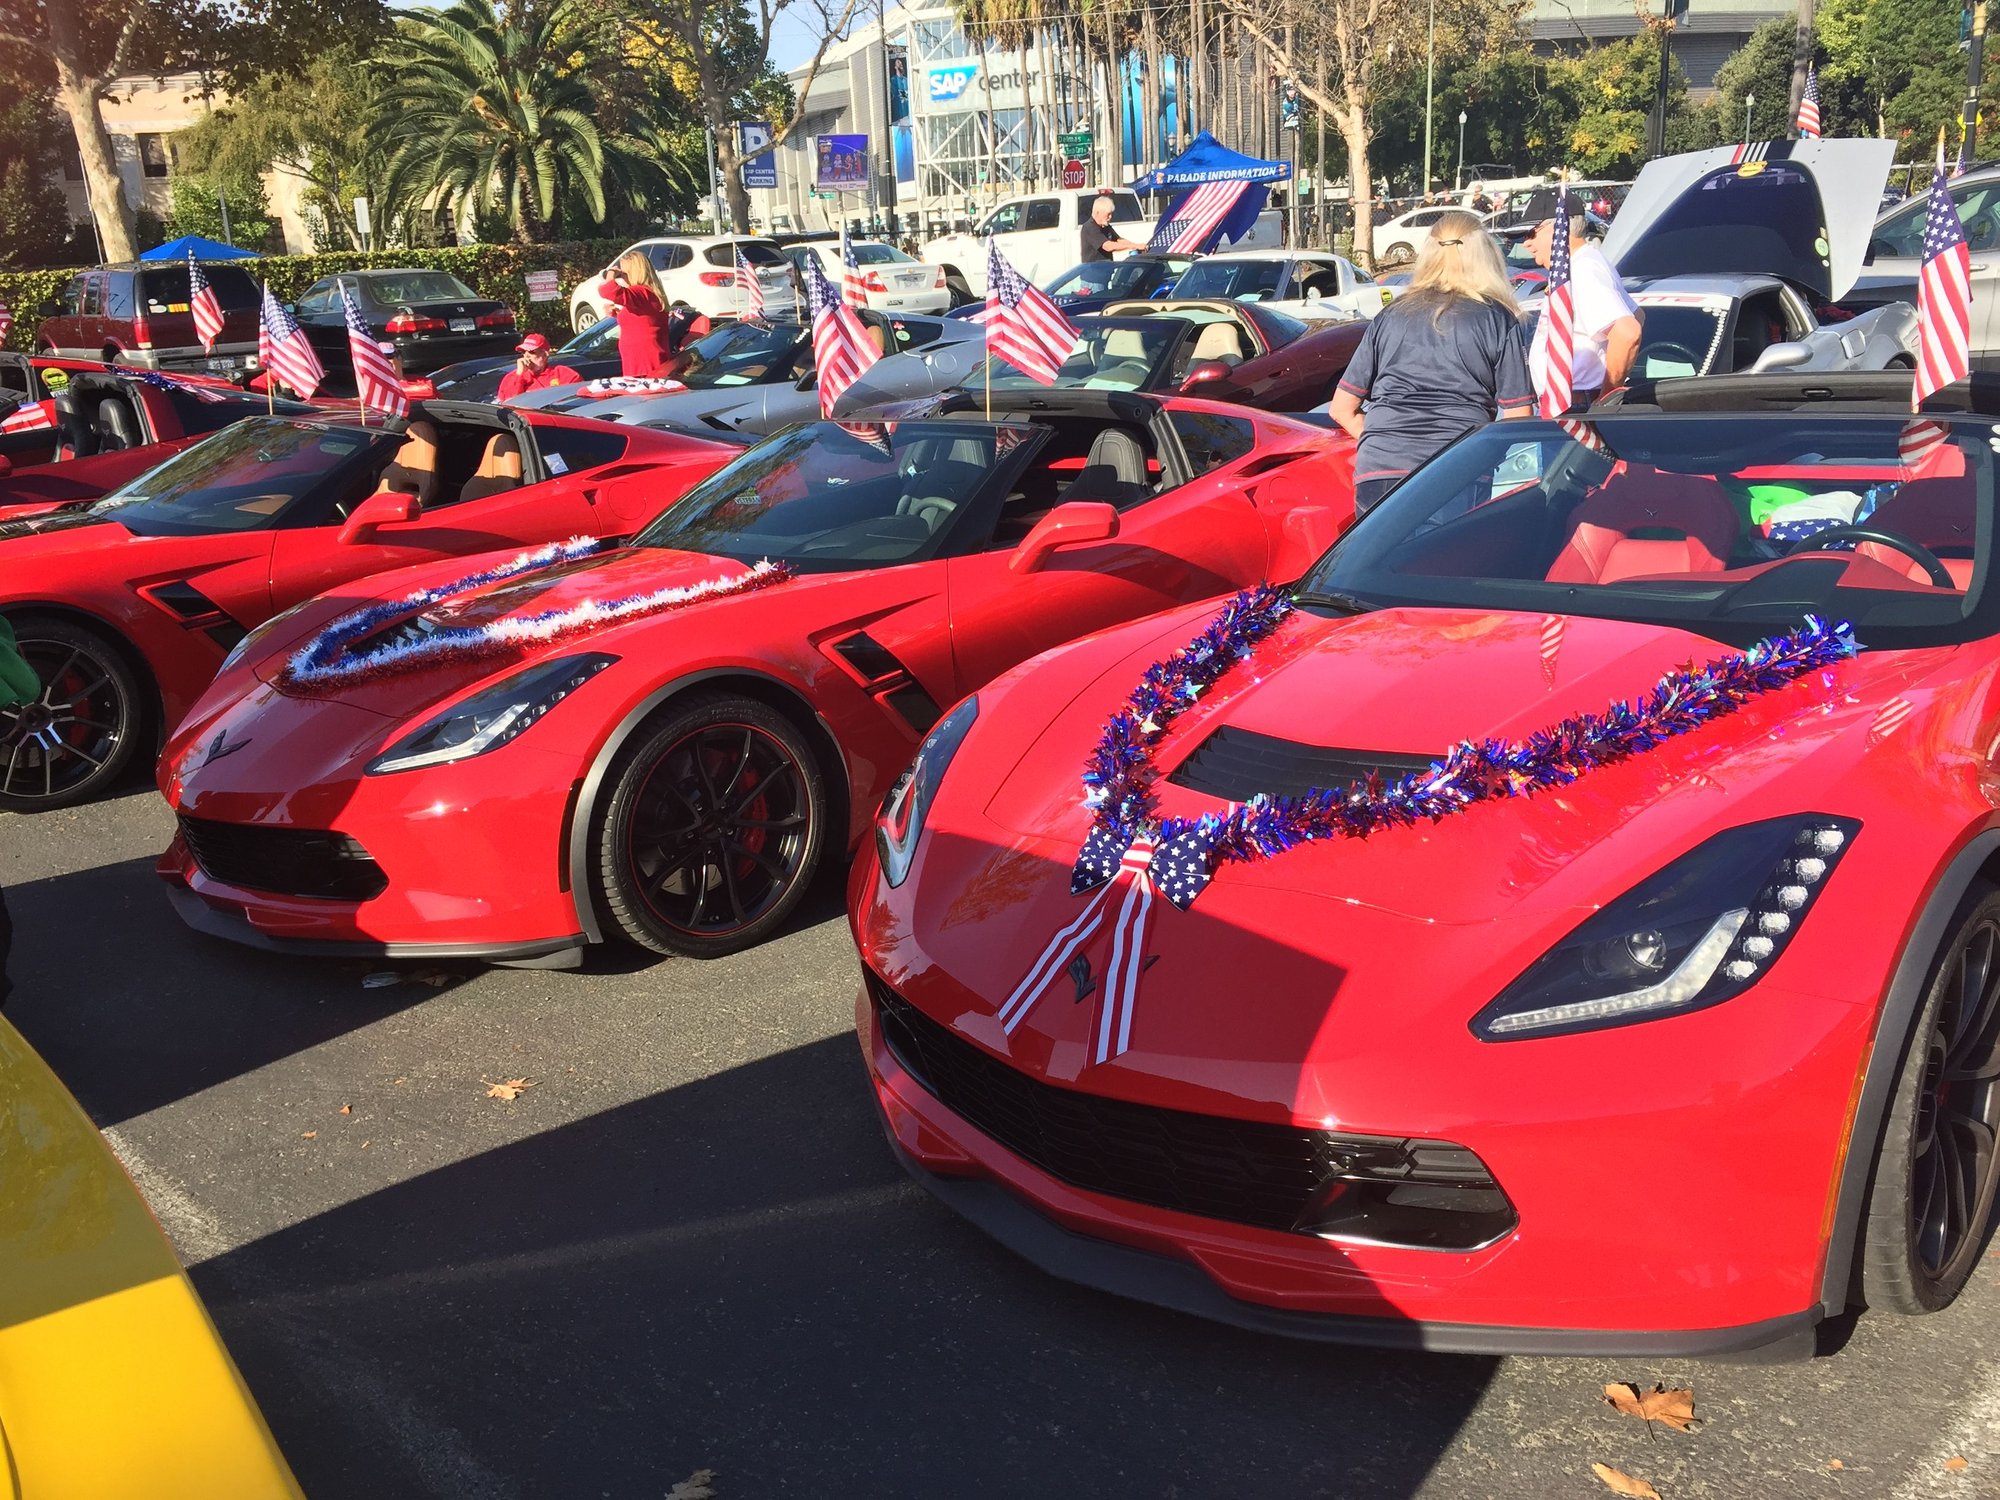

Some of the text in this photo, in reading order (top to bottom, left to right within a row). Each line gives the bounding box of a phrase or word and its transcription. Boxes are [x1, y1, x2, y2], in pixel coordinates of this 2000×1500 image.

[930, 72, 967, 95] SAP
[748, 177, 774, 185] PARKING
[1064, 170, 1085, 185] STOP
[1166, 166, 1276, 183] PARADE INFORMATION
